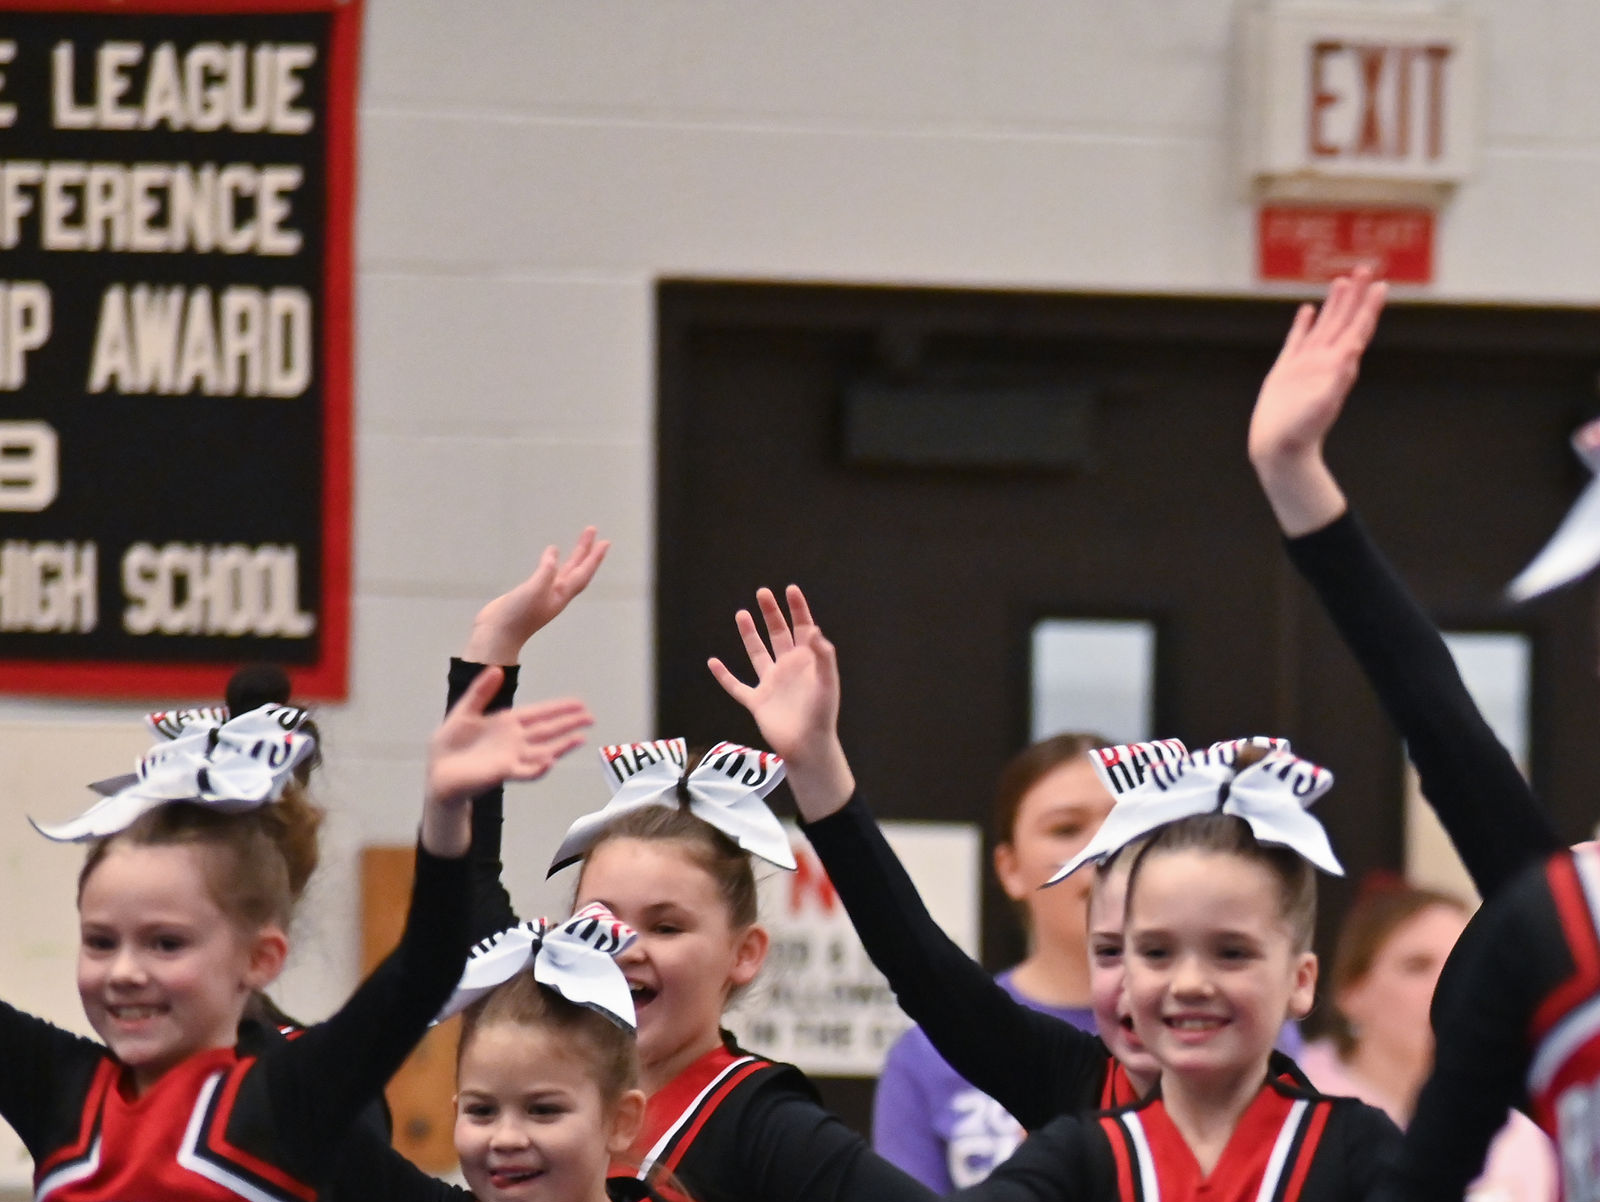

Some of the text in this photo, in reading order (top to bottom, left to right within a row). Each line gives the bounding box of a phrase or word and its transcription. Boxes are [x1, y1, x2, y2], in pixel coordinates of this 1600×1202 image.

[52, 40, 317, 133] LEAGUE
[1311, 40, 1452, 160] EXIT
[0, 160, 303, 256] FERENCE
[88, 284, 312, 397] AWARD
[0, 540, 316, 638] IGH SCHOOL
